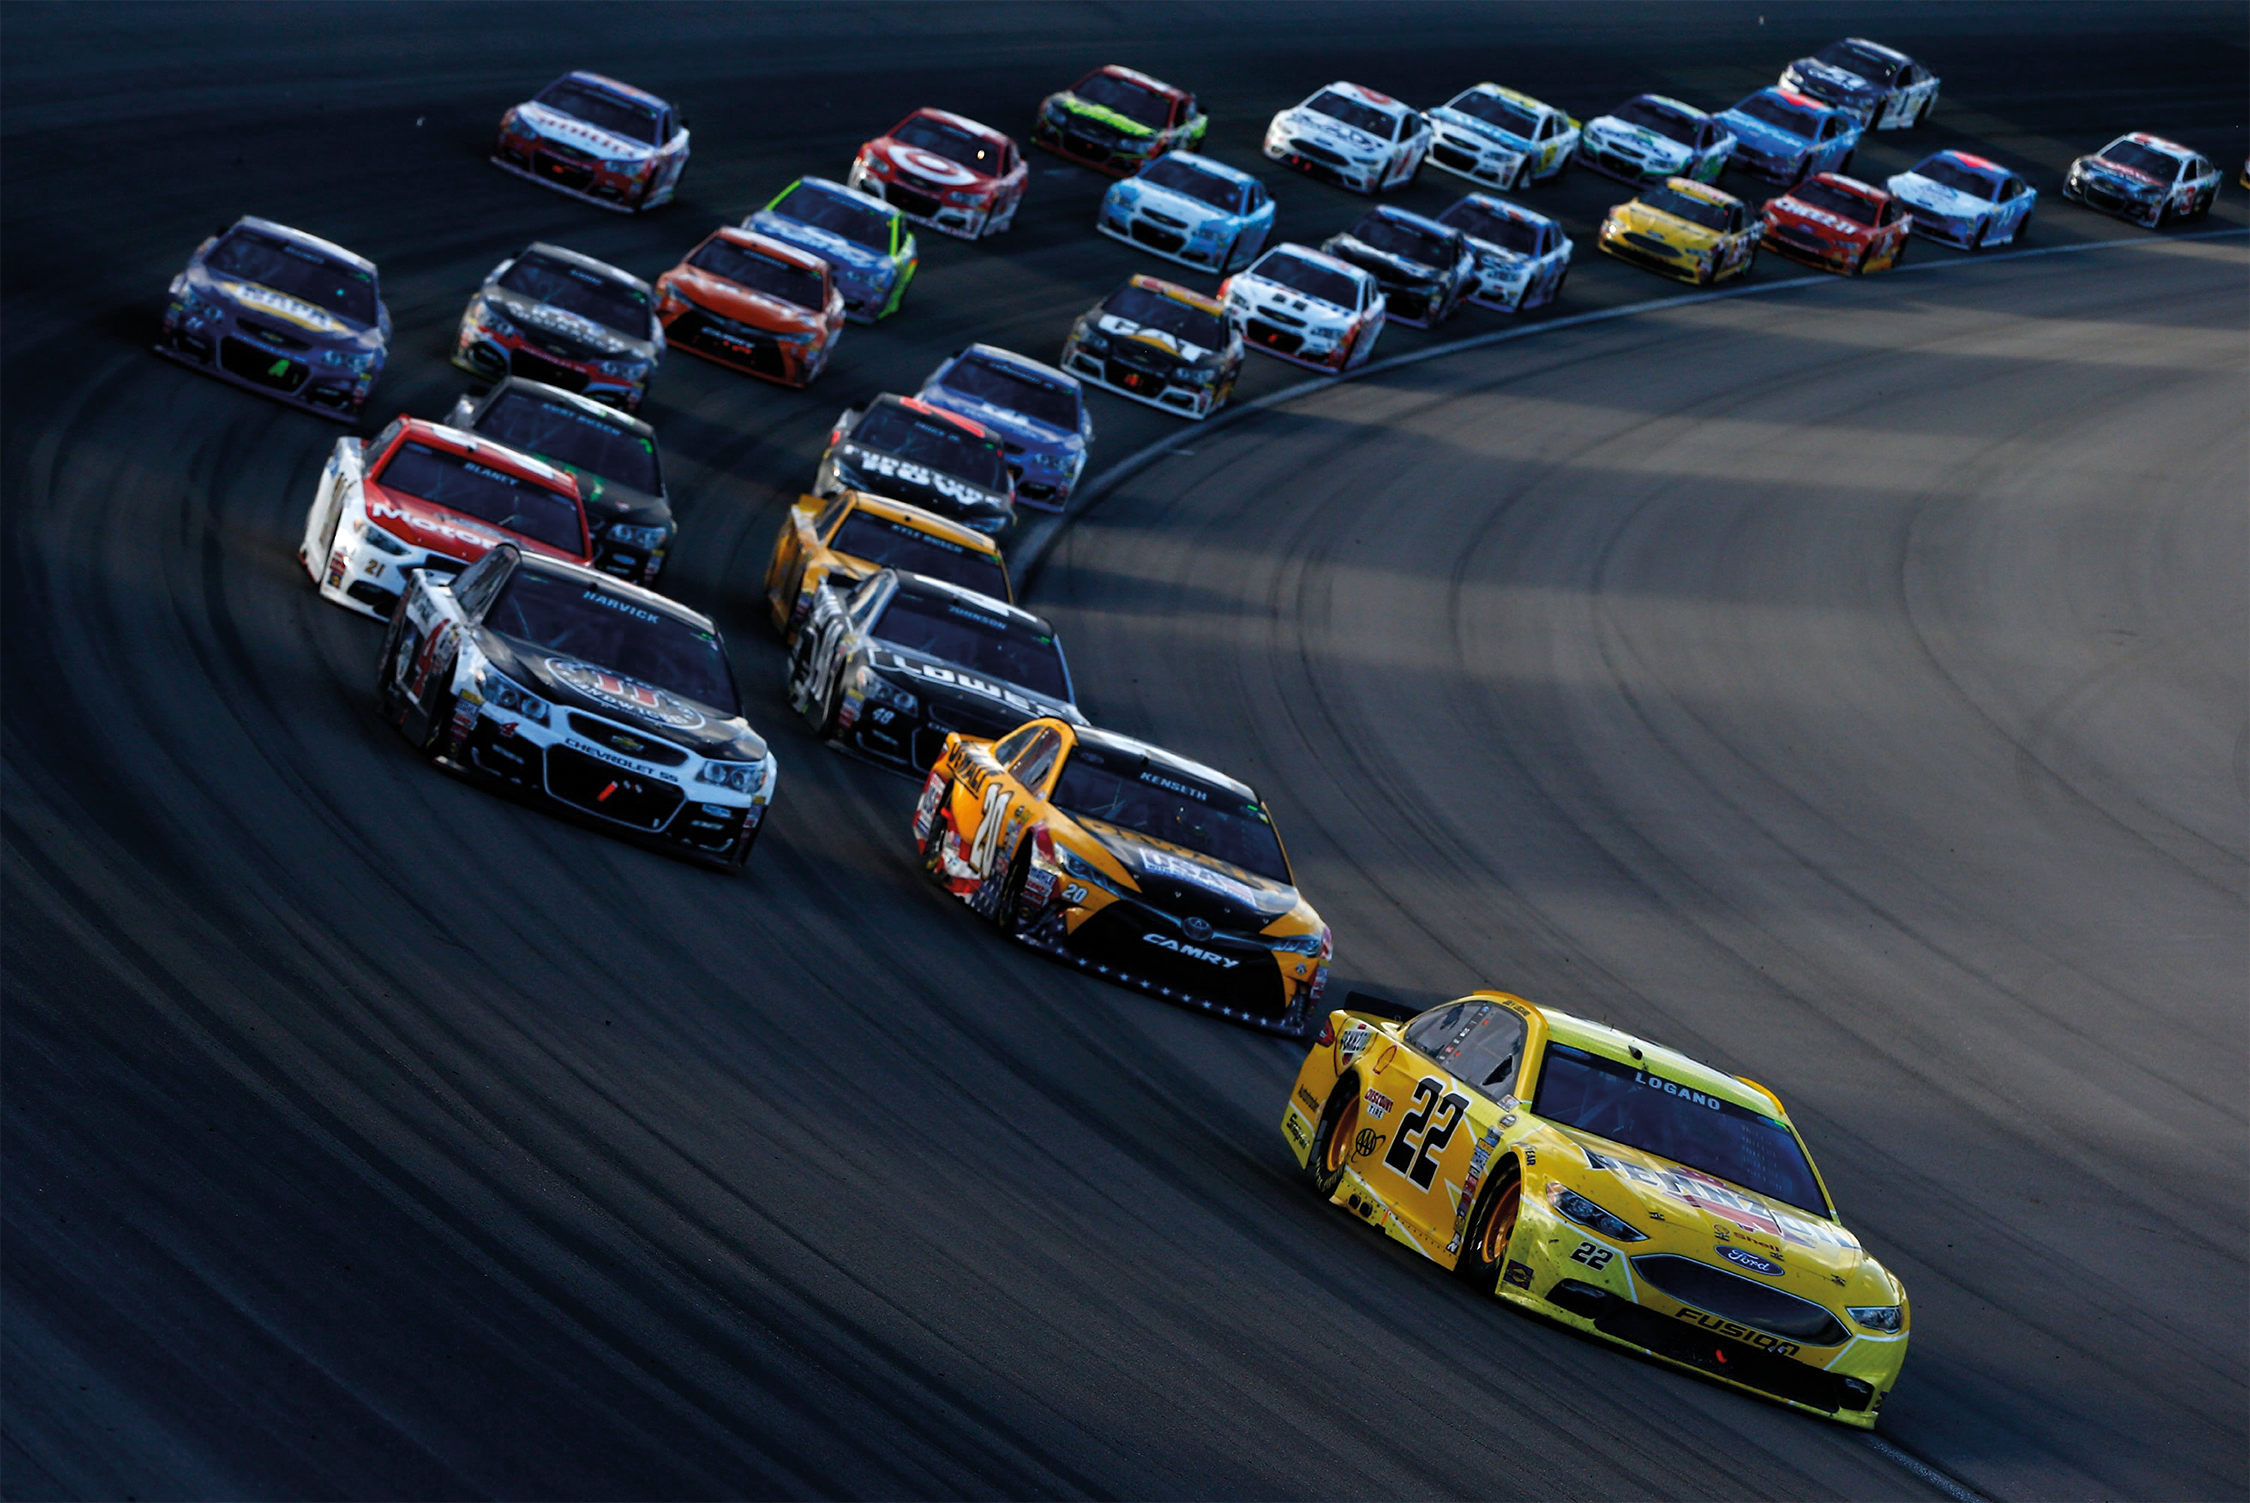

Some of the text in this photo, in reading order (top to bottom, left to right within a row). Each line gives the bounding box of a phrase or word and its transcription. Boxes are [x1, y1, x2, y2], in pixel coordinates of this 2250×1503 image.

[463, 462, 520, 486] BLANEY
[364, 559, 386, 578] 21
[583, 589, 661, 624] HARVICK
[948, 604, 1008, 630] JOHNSON
[872, 707, 896, 725] 48
[565, 737, 680, 783] CHEVROLET SS
[1140, 770, 1208, 801] KENSETH
[1061, 882, 1090, 904] 20
[1142, 933, 1240, 969] CAMRY
[1364, 1087, 1395, 1114] DISCOUNT
[1634, 1071, 1721, 1111] LOGANO
[1367, 1104, 1385, 1120] TIRE
[1383, 1075, 1472, 1195] 22
[1569, 1241, 1614, 1271] 22
[1733, 1231, 1781, 1254] Shell
[1727, 1249, 1771, 1273] Ford
[1674, 1307, 1801, 1357] FUSION
